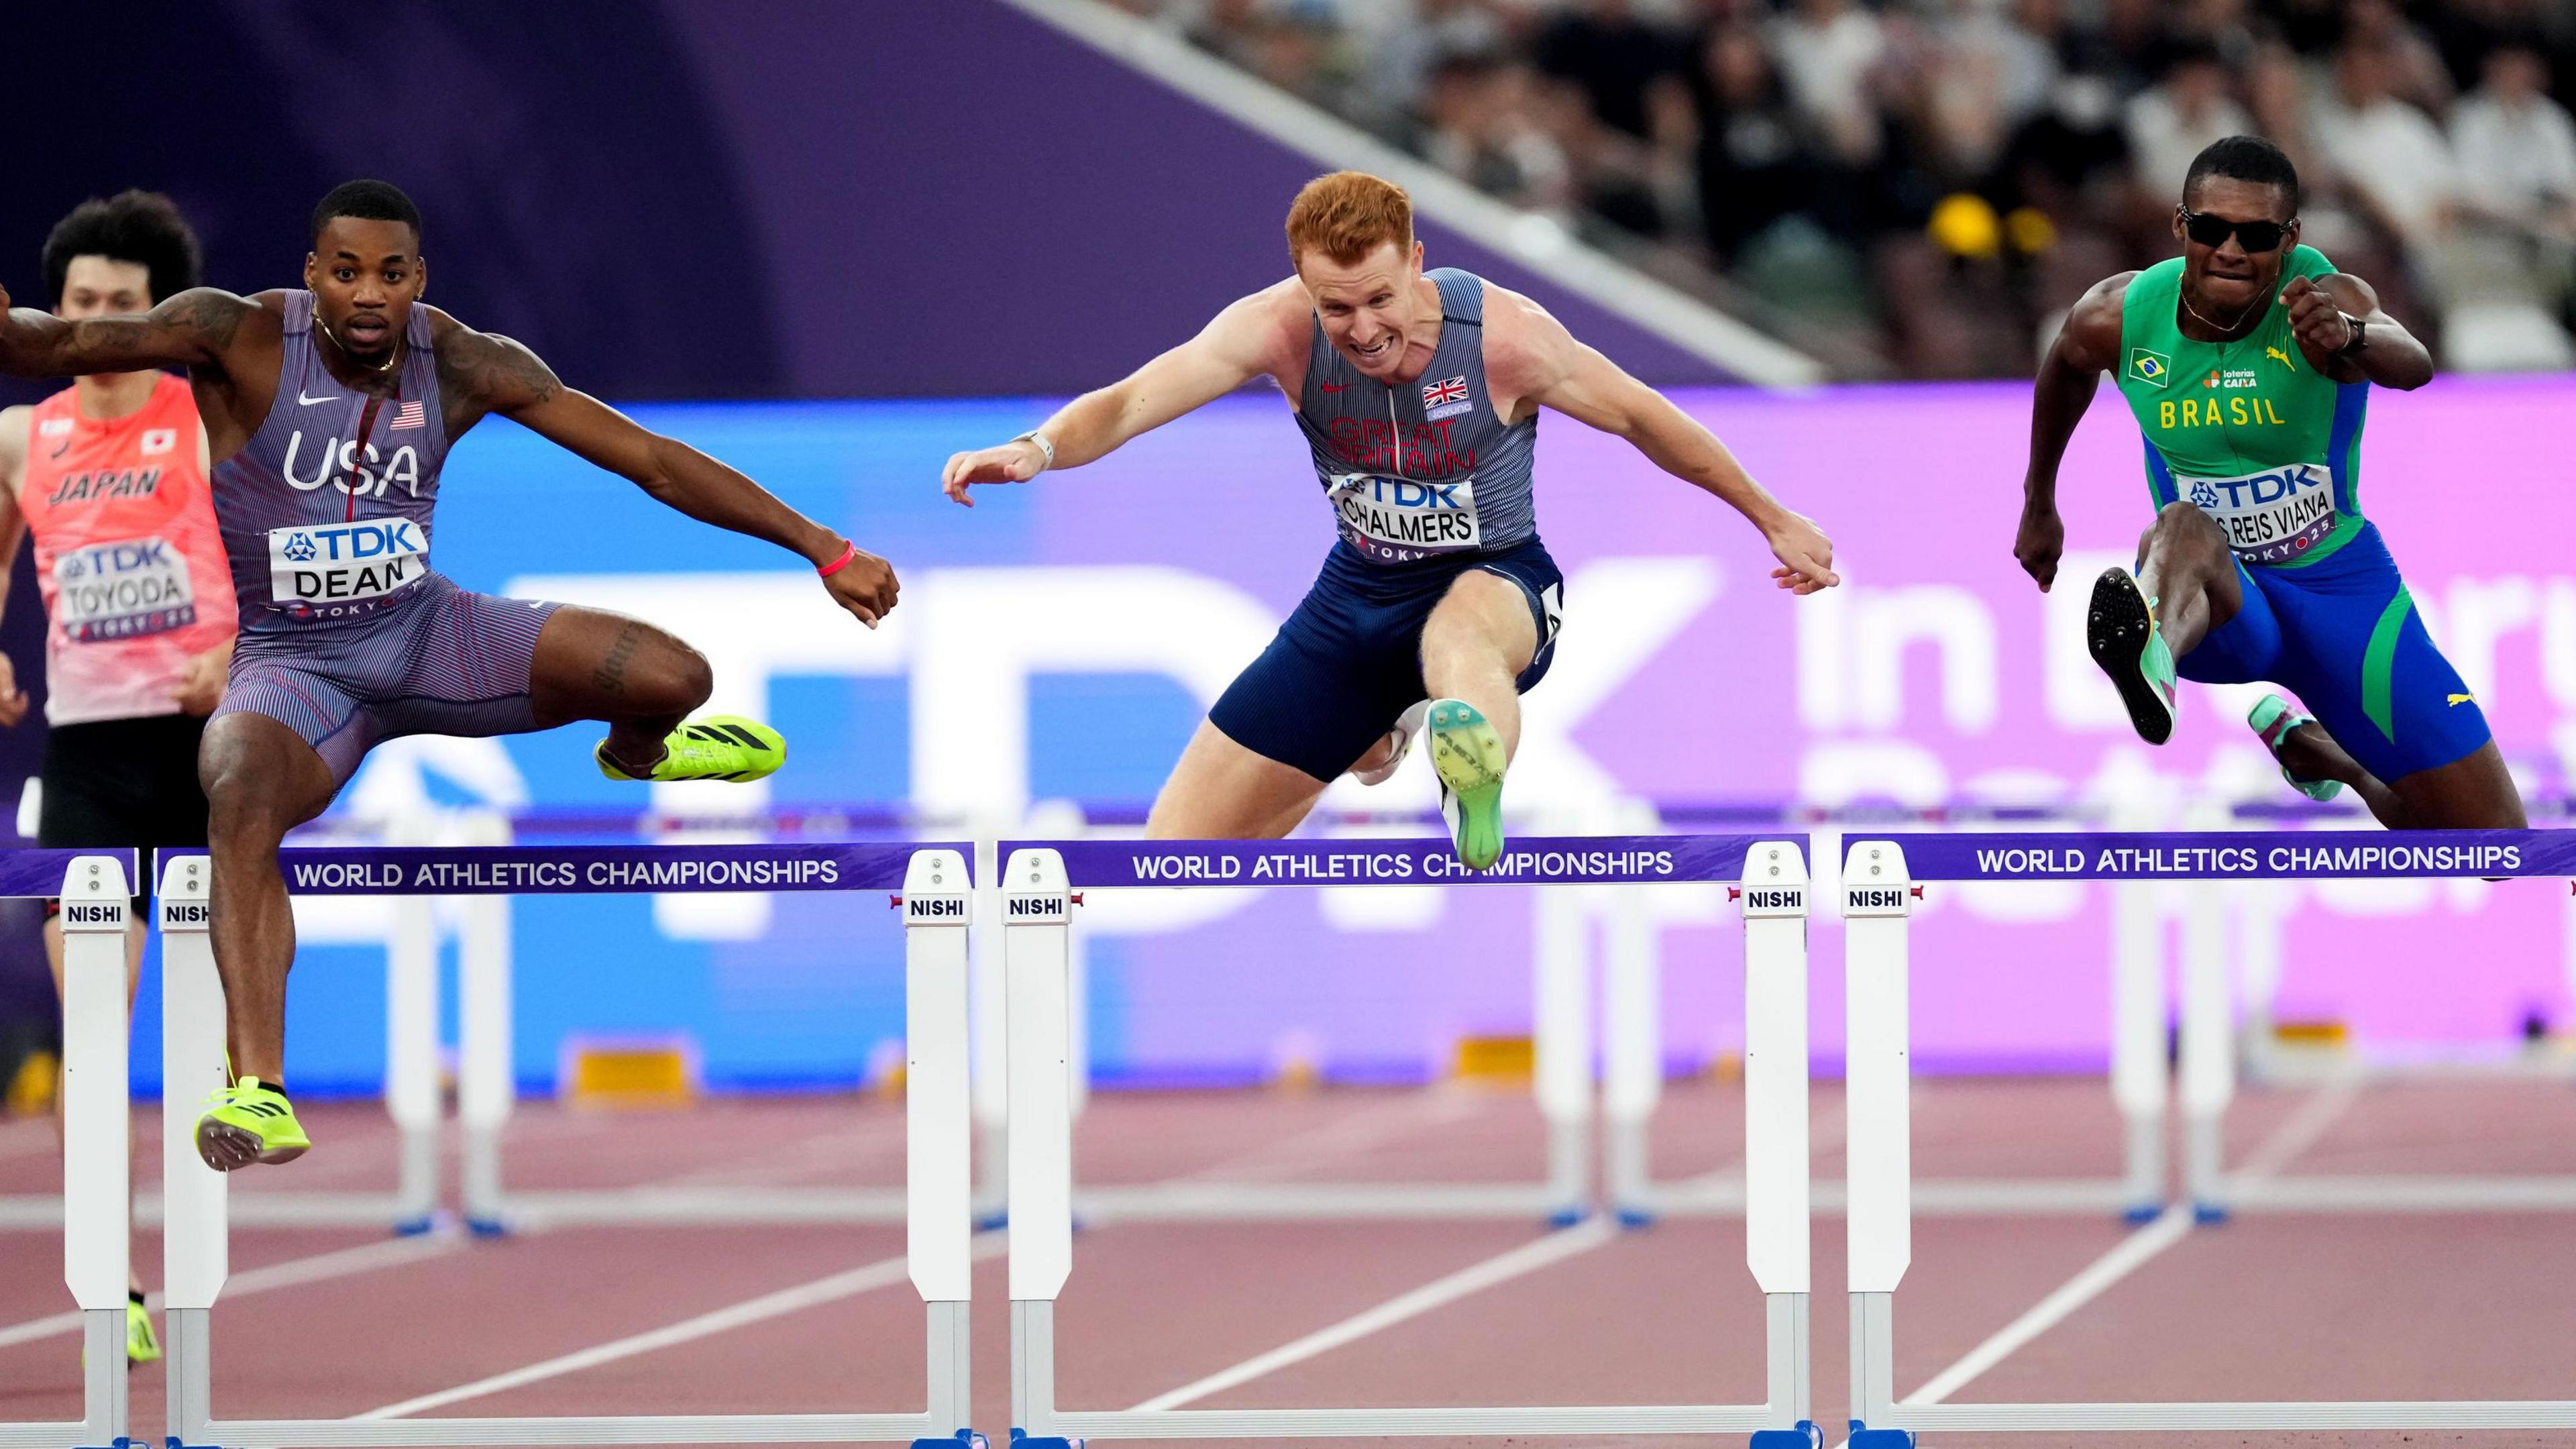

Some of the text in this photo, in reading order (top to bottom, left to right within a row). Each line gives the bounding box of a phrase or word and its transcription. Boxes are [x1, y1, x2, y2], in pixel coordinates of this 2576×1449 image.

[2223, 368, 2255, 378] loterias
[2223, 378, 2257, 388] CAIXA
[2160, 397, 2285, 428] BRASIL
[1332, 417, 1456, 449] GREAT
[283, 430, 417, 497] USA
[1329, 439, 1475, 476] BRITAIN
[49, 468, 160, 504] JAPAN
[1366, 475, 1462, 508] TDK
[2215, 466, 2320, 508] TDK
[1342, 496, 1471, 543] CHALMERS
[2231, 513, 2273, 544] REIS
[2273, 490, 2329, 535] VIANA
[91, 539, 171, 574] TDK
[315, 523, 418, 560] TDK
[294, 557, 404, 598] DEAN
[68, 576, 182, 614] TOYODA
[294, 859, 839, 888] WORLD ATHLETICS CHAMPIONSHIPS
[1132, 855, 1241, 879] WORLD
[1251, 853, 1413, 878] ATHLETICS
[1976, 845, 2521, 873] WORLD ATHLETICS CHAMPIONSHIPS
[68, 906, 121, 922] NISHI
[166, 906, 209, 922] NISH
[911, 900, 963, 916] NISHI
[1010, 898, 1062, 915] NISHI
[1749, 891, 1801, 908] NISHI
[1850, 891, 1902, 907] NISHI
